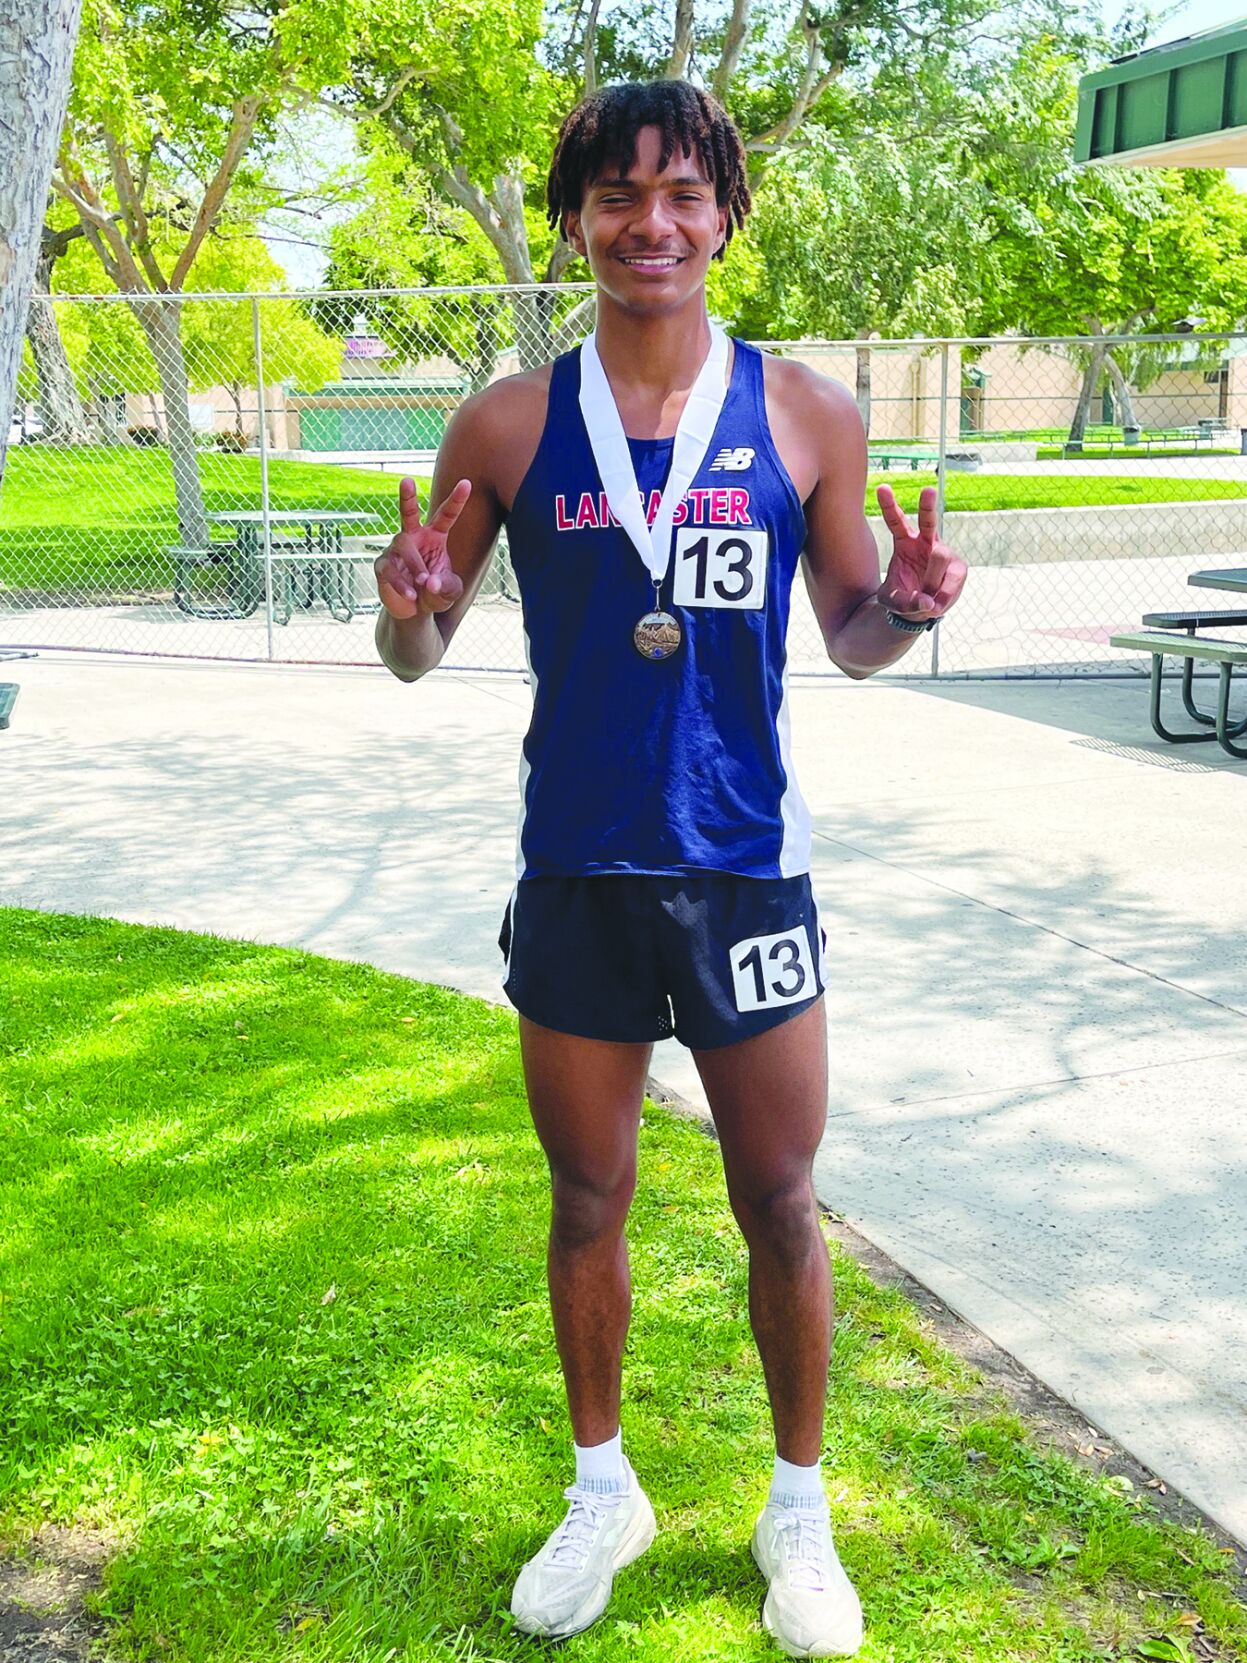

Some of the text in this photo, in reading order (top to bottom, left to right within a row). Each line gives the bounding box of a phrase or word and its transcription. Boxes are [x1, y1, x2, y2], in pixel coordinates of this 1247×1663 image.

[708, 447, 756, 471] NB
[556, 488, 752, 531] LANASTER
[683, 537, 753, 601] 13
[738, 939, 805, 1003] 13
